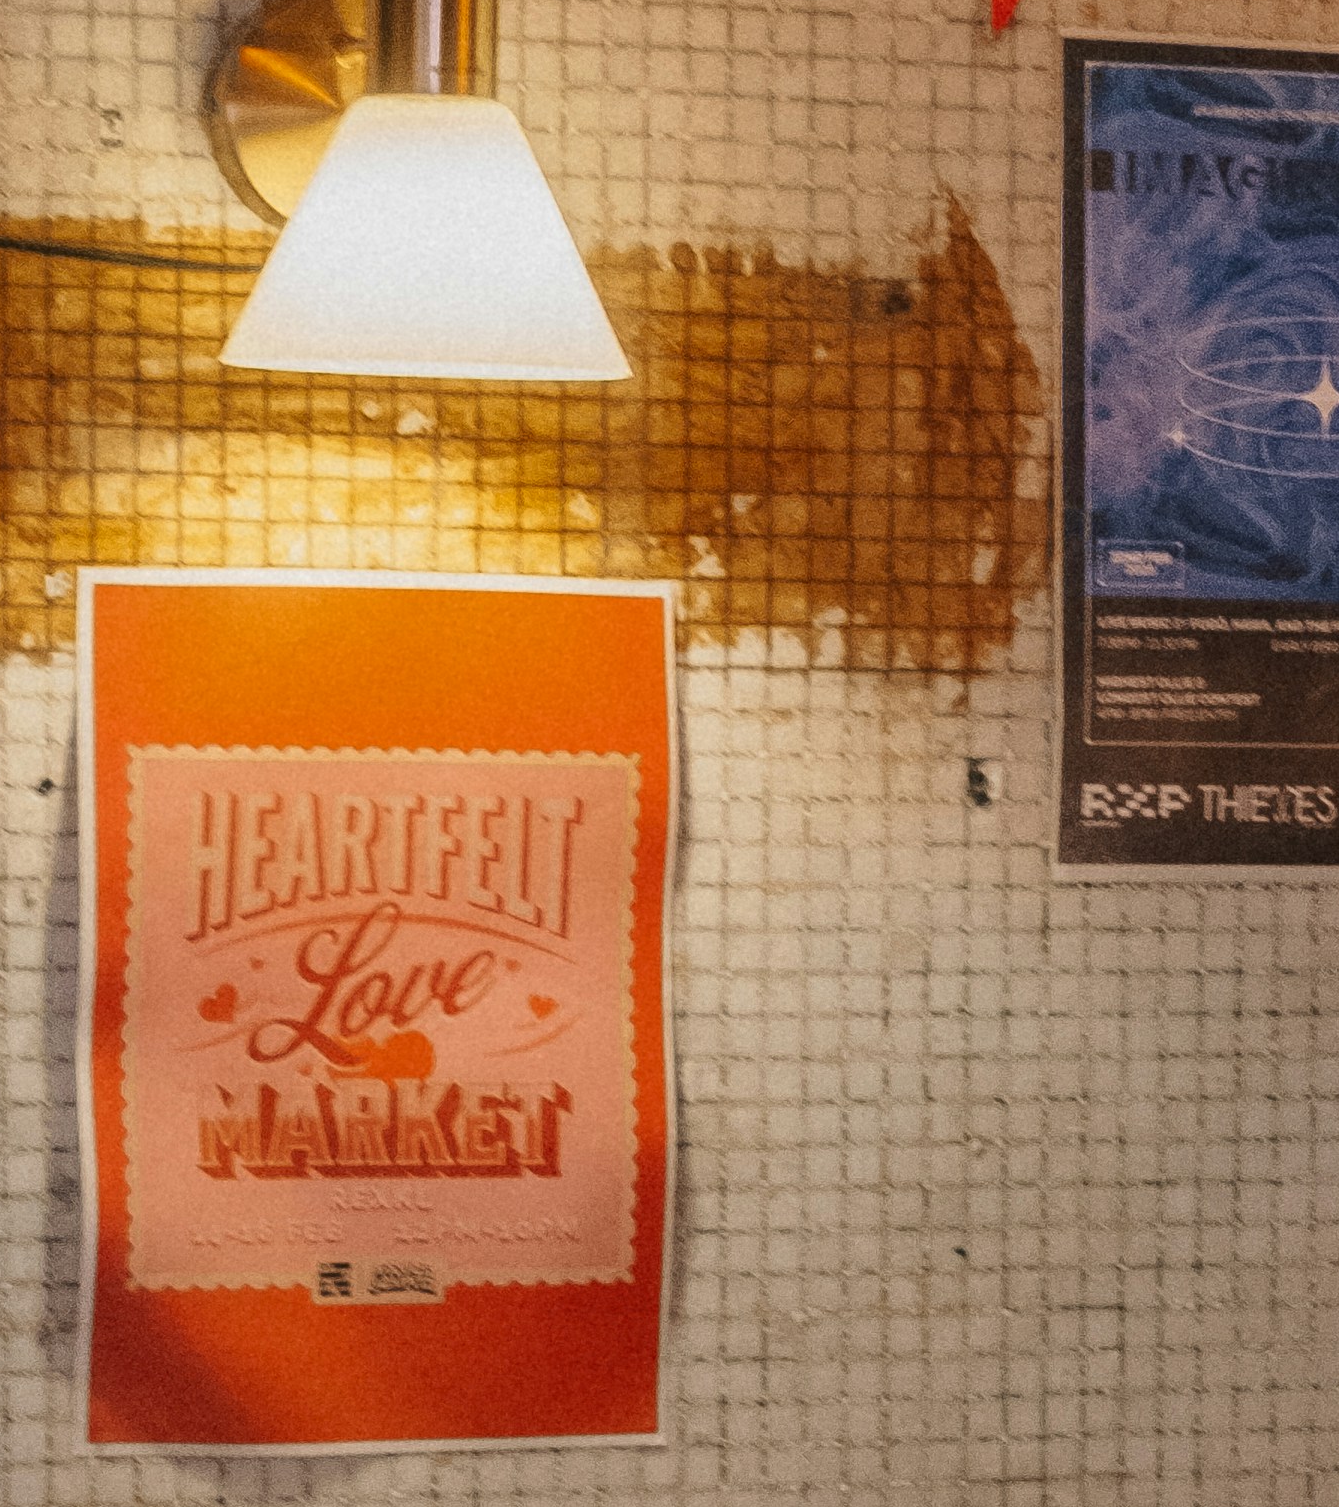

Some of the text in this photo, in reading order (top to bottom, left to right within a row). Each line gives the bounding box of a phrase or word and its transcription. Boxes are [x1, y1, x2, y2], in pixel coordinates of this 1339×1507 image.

[184, 789, 586, 943] HEARTFELT
[248, 900, 496, 1066] Love
[196, 1079, 575, 1181] MARKET
